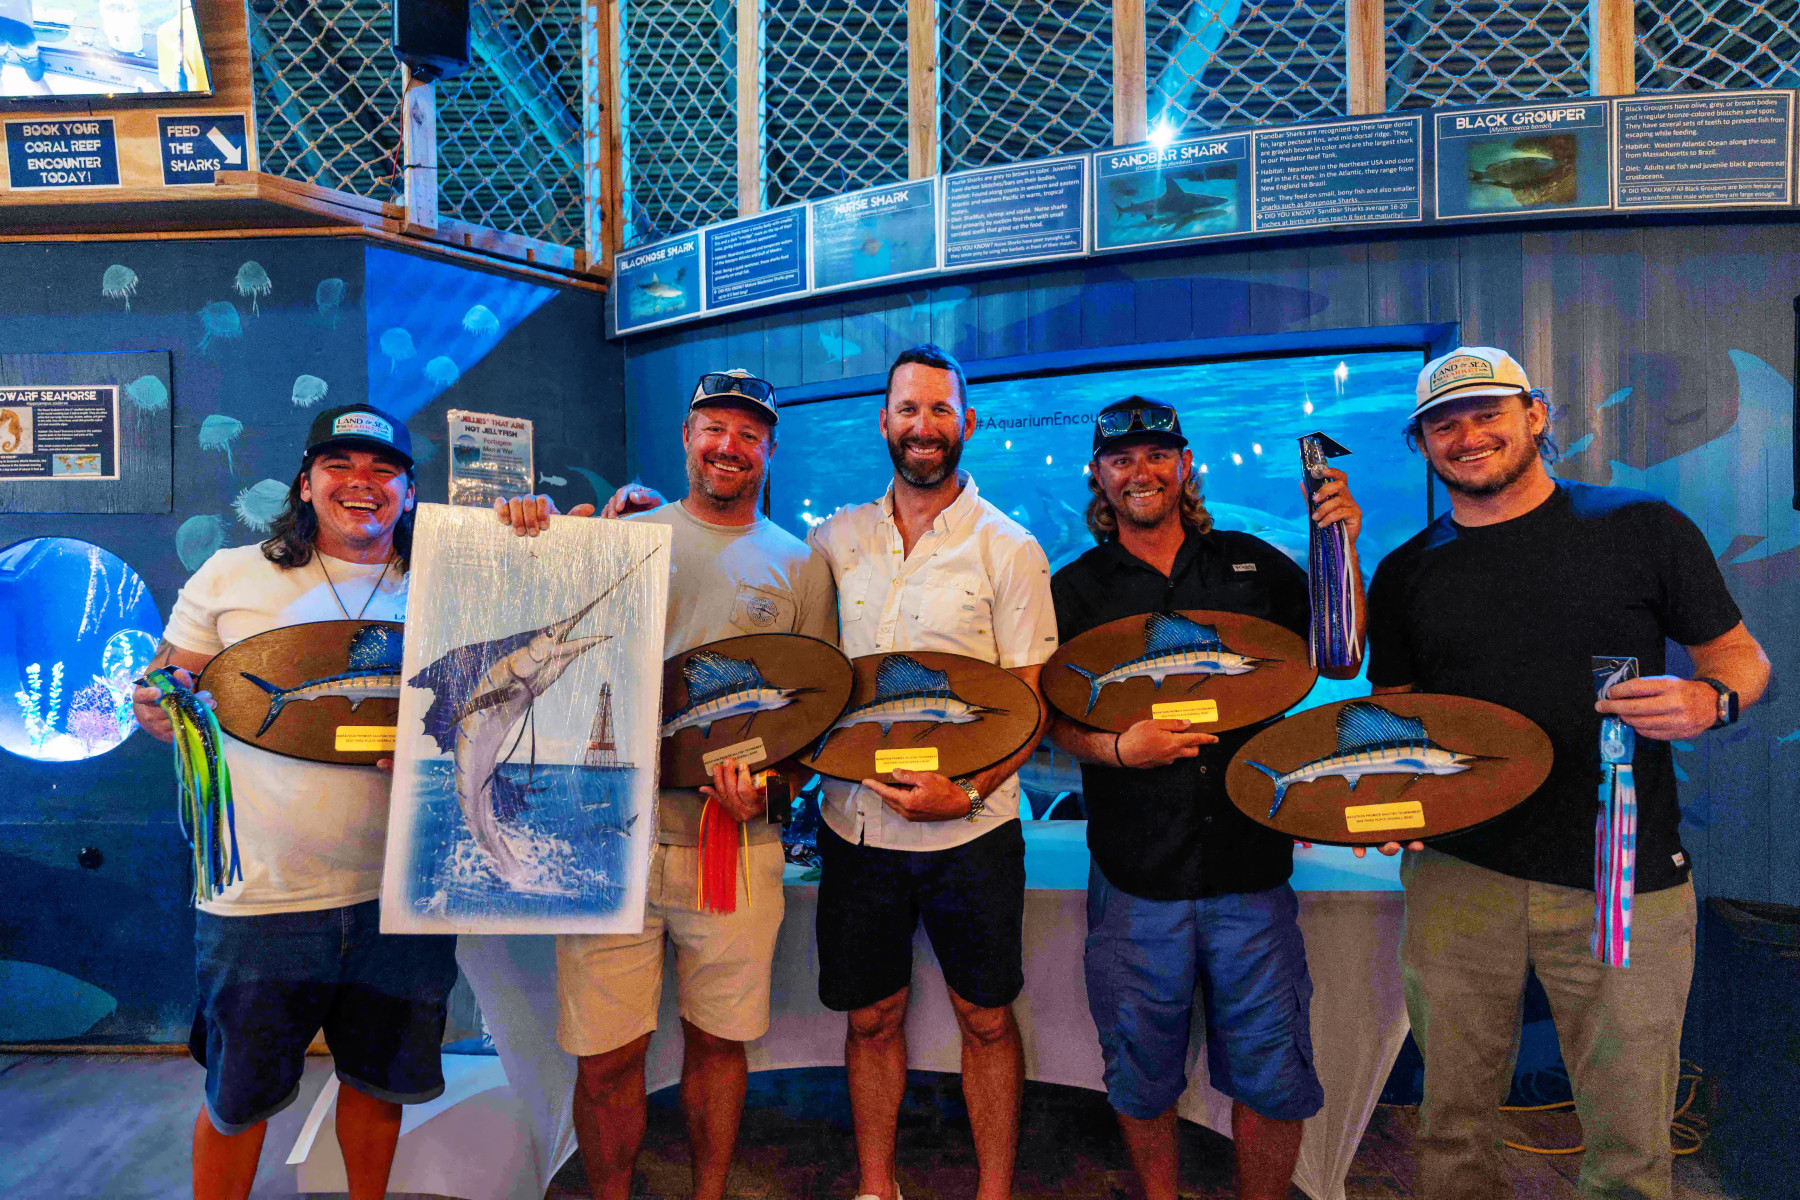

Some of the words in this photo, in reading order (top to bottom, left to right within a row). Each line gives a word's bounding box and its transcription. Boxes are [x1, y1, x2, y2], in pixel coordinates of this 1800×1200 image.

[1643, 104, 1673, 112] Groupers
[1456, 114, 1508, 129] BLACK
[1512, 108, 1586, 125] GROUPER
[23, 124, 60, 136] BOOK
[63, 123, 100, 135] YOUR
[167, 126, 200, 137] FEED
[1673, 129, 1698, 137] feeding.
[1288, 138, 1312, 147] pectoral
[1374, 131, 1391, 139] ridge.
[25, 142, 69, 153] CORAL
[71, 140, 101, 152] REEF
[168, 142, 193, 154] THE
[1271, 148, 1293, 156] grayish
[1375, 139, 1395, 147] largest
[1112, 150, 1177, 169] SANDBAR
[1180, 142, 1228, 158] SHARK
[28, 157, 101, 170] ENCOUNTER
[171, 158, 220, 171] SHARKS
[40, 171, 91, 184] TODAY!
[835, 199, 868, 216] NURSE
[871, 191, 909, 207] SHARK
[621, 250, 665, 270] BLACKNOSE
[668, 241, 694, 257] SHARK
[1433, 364, 1458, 378] LAND
[41, 391, 96, 401] SEAHORSE
[372, 421, 389, 431] SEA
[482, 428, 517, 437] JELLYFISH
